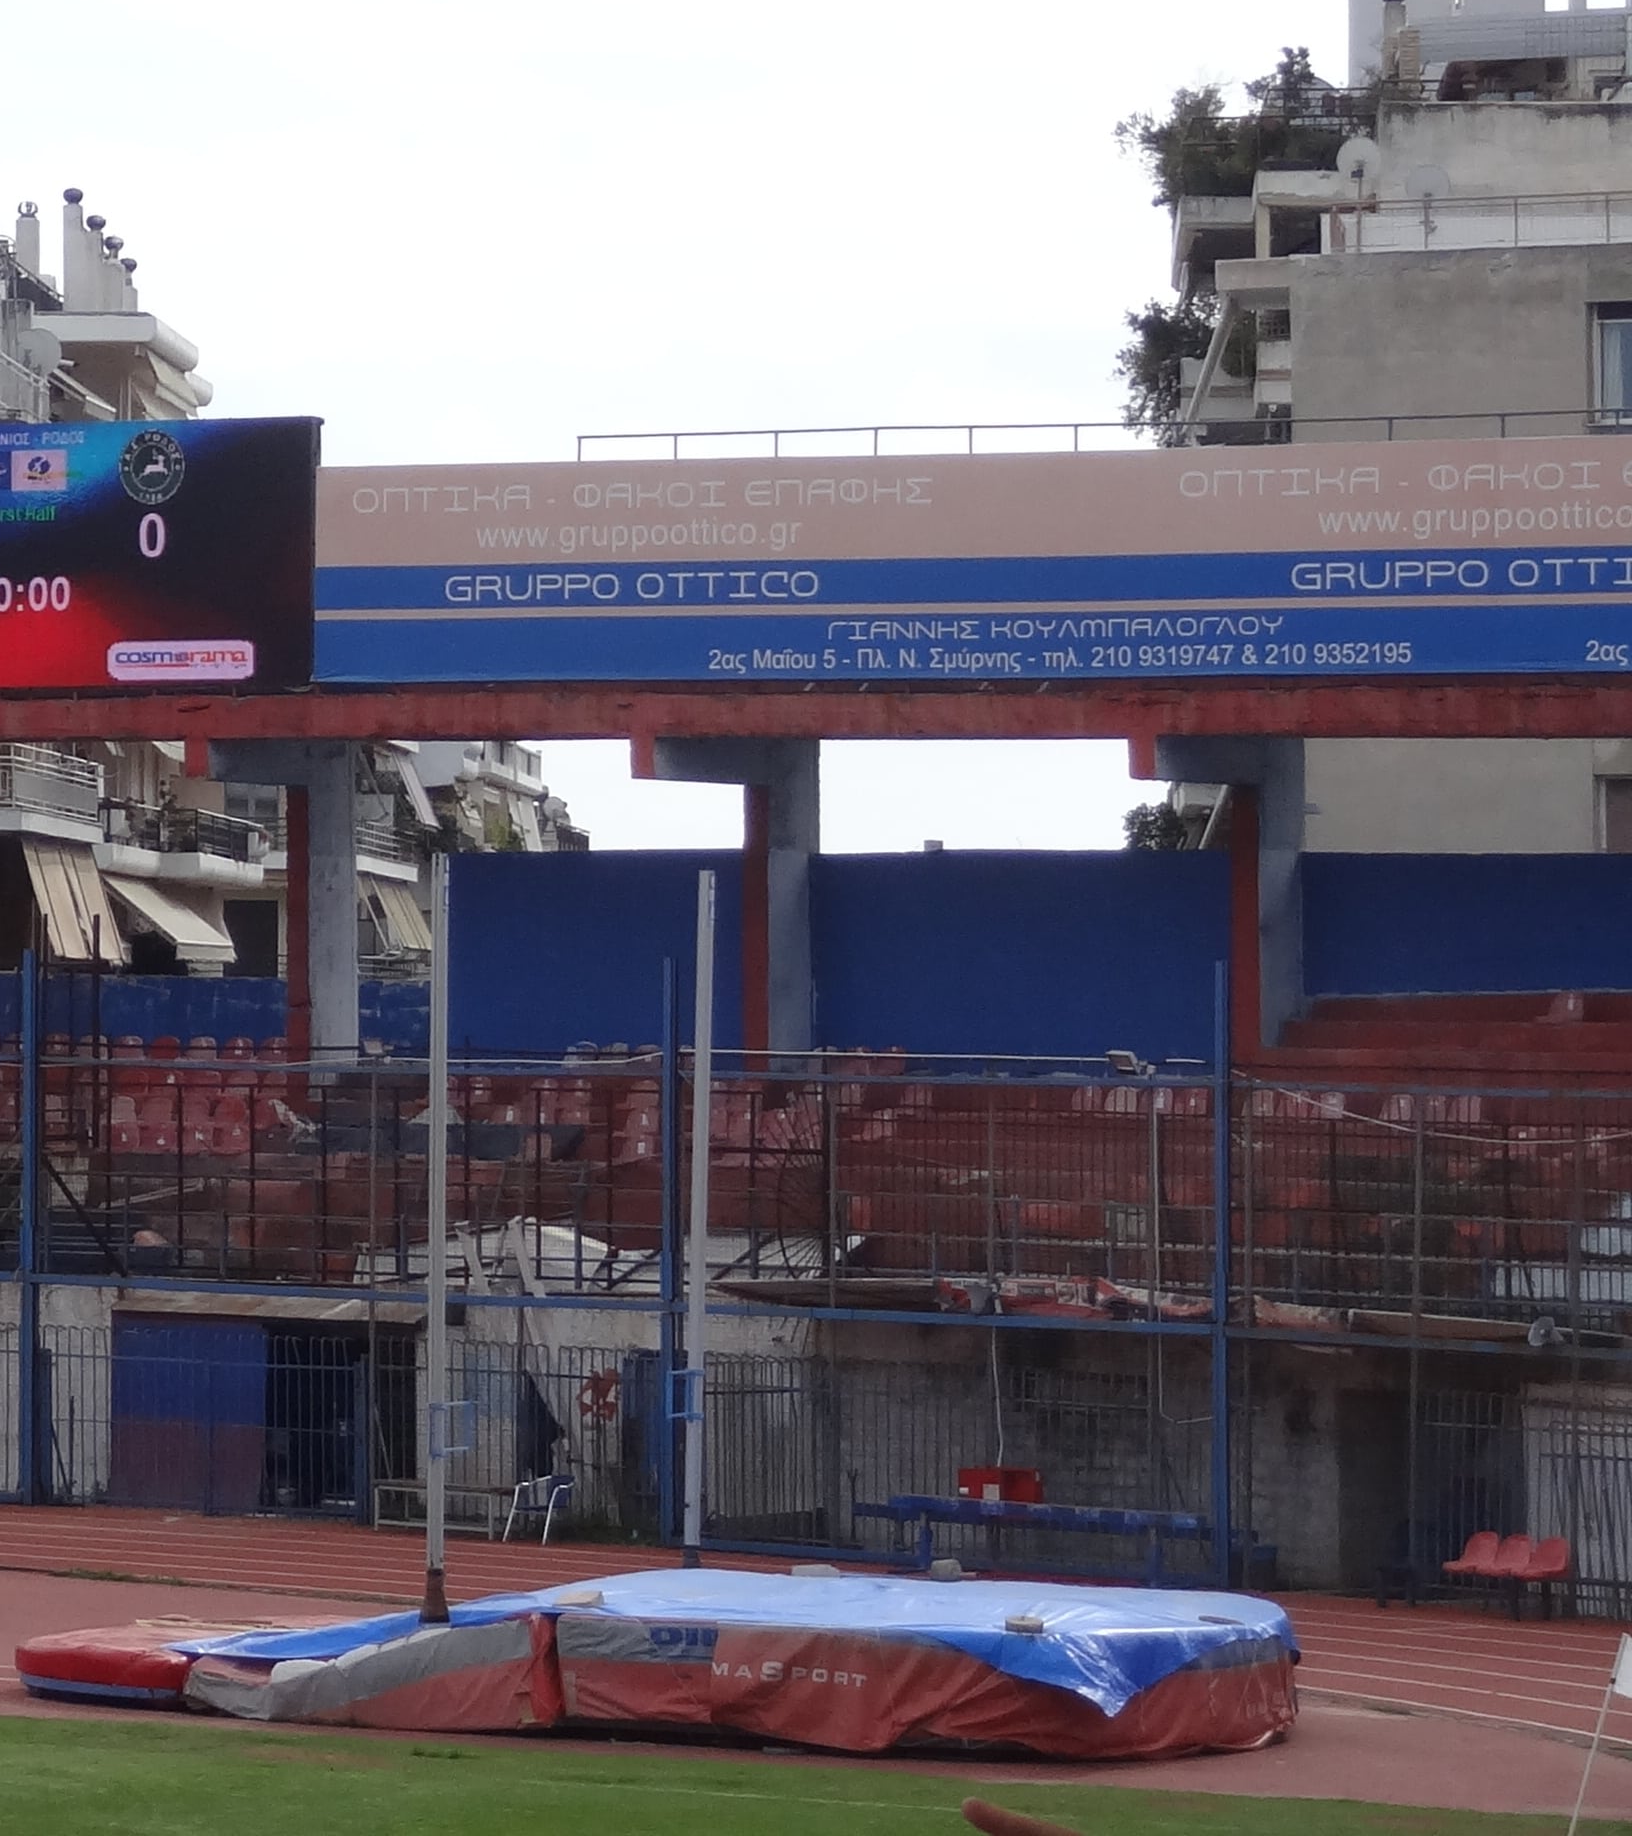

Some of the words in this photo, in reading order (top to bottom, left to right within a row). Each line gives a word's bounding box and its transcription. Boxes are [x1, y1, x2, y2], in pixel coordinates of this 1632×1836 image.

[352, 483, 531, 513] ΟΠΤΙΚΑ
[572, 480, 726, 510] ΦΑΚΟΙ
[744, 477, 934, 507] ΕΠΑΦΗΣ
[1179, 467, 1380, 498] ΟΠΤΙΚΑ
[1427, 462, 1601, 493] ΦΑΚΟΙ
[24, 505, 56, 522] Half
[139, 512, 166, 558] 0
[475, 517, 802, 555] www.gruppoottico.gr
[444, 574, 620, 602] GRUPPO
[635, 571, 821, 599] OTTICO
[1290, 559, 1489, 591] GRUPPO
[827, 620, 981, 641] ΓΙΑΝΝΗΣ
[708, 649, 747, 674] 2ας
[822, 648, 836, 669] 5
[857, 648, 892, 669] Πλ.
[929, 646, 1022, 674] Σμύρνης
[1042, 645, 1084, 673] τηλ.
[1090, 646, 1132, 667] 210
[1138, 644, 1234, 667] 9319747
[1241, 644, 1259, 666] &
[1264, 644, 1307, 666] 210
[1313, 642, 1412, 665] 9352195
[1585, 639, 1629, 666] 2ας
